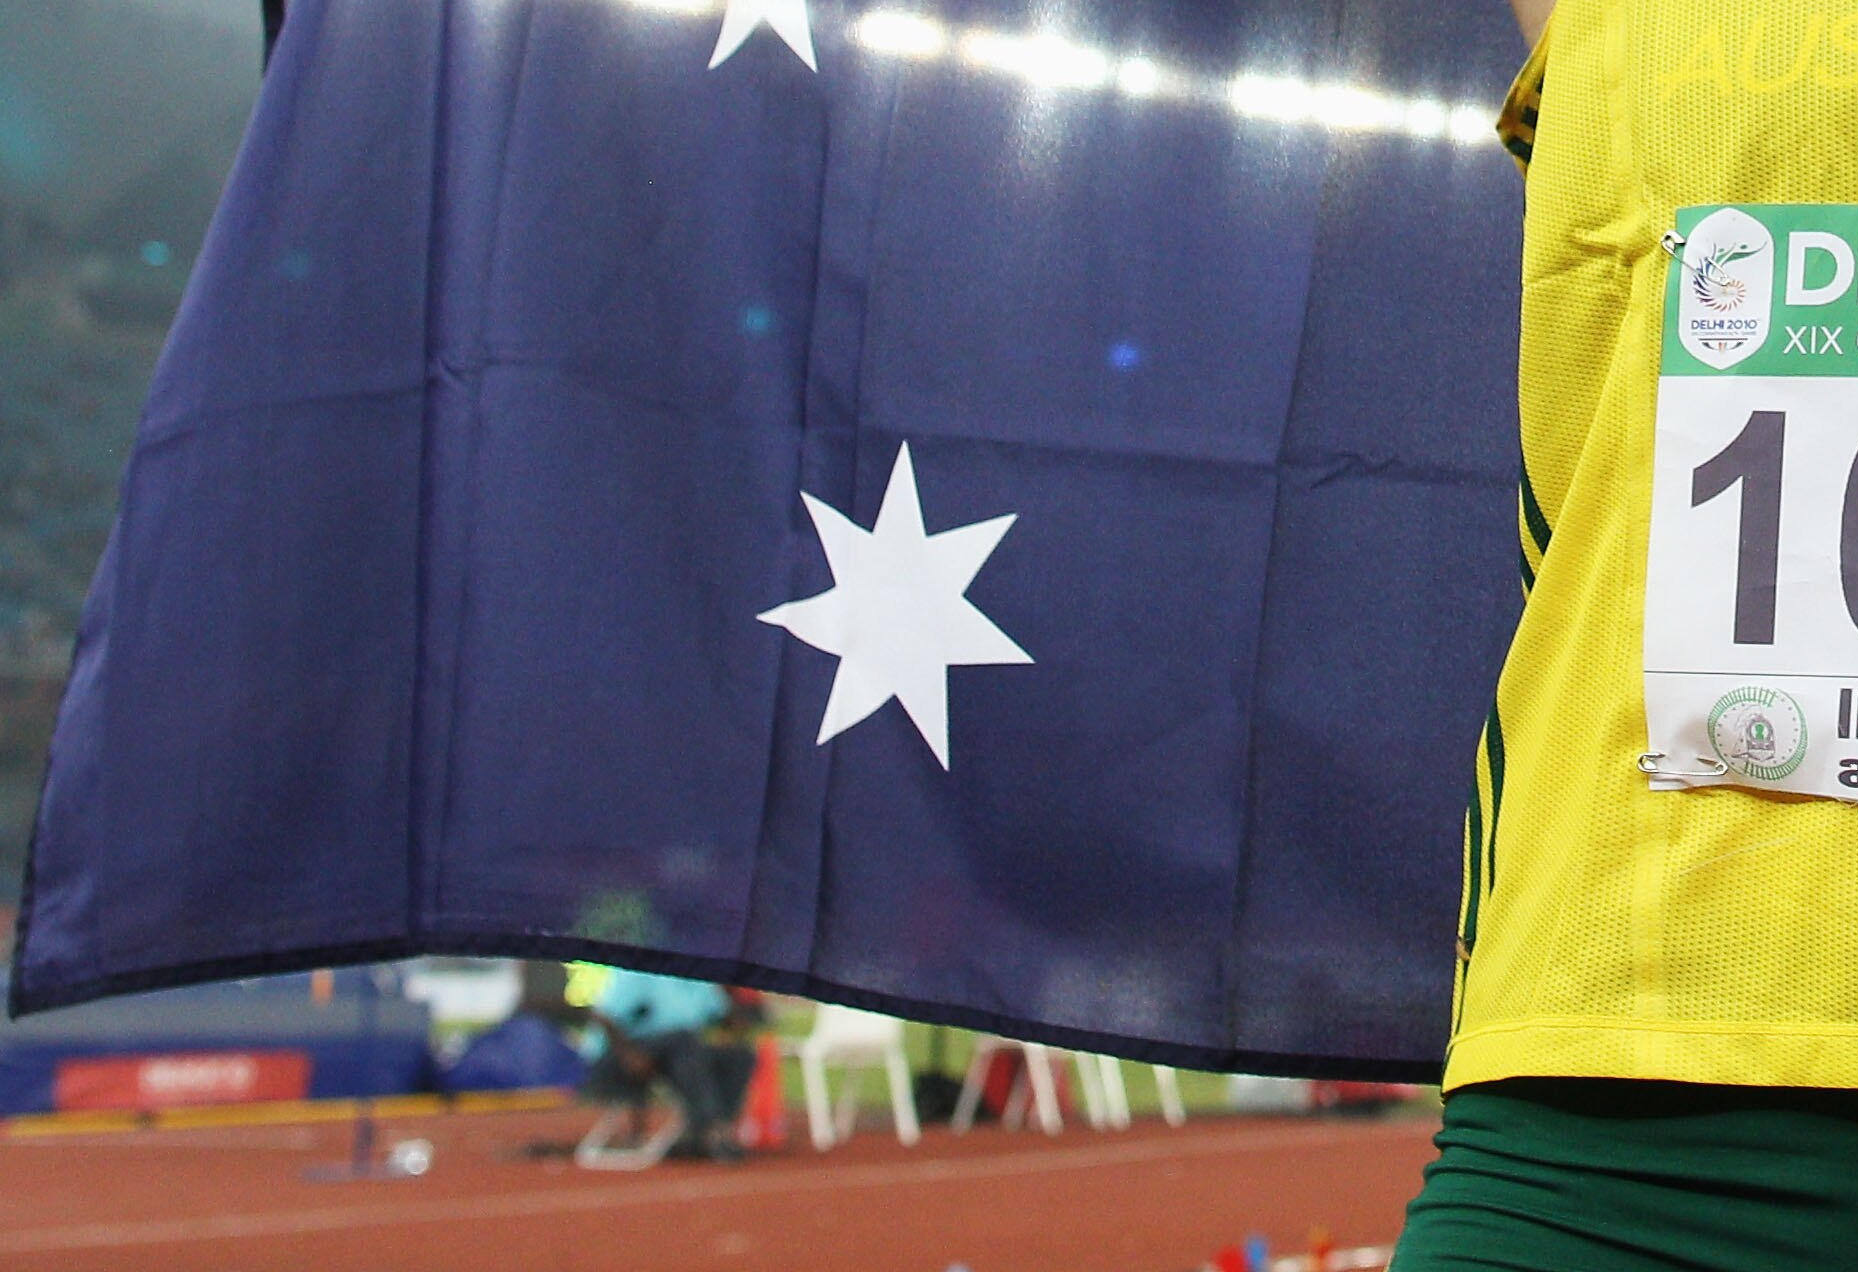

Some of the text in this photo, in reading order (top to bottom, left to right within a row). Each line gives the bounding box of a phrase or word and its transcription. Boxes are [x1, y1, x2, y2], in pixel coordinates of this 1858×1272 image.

[1691, 319, 1757, 330] DELHI 2010
[1783, 329, 1844, 356] XIX
